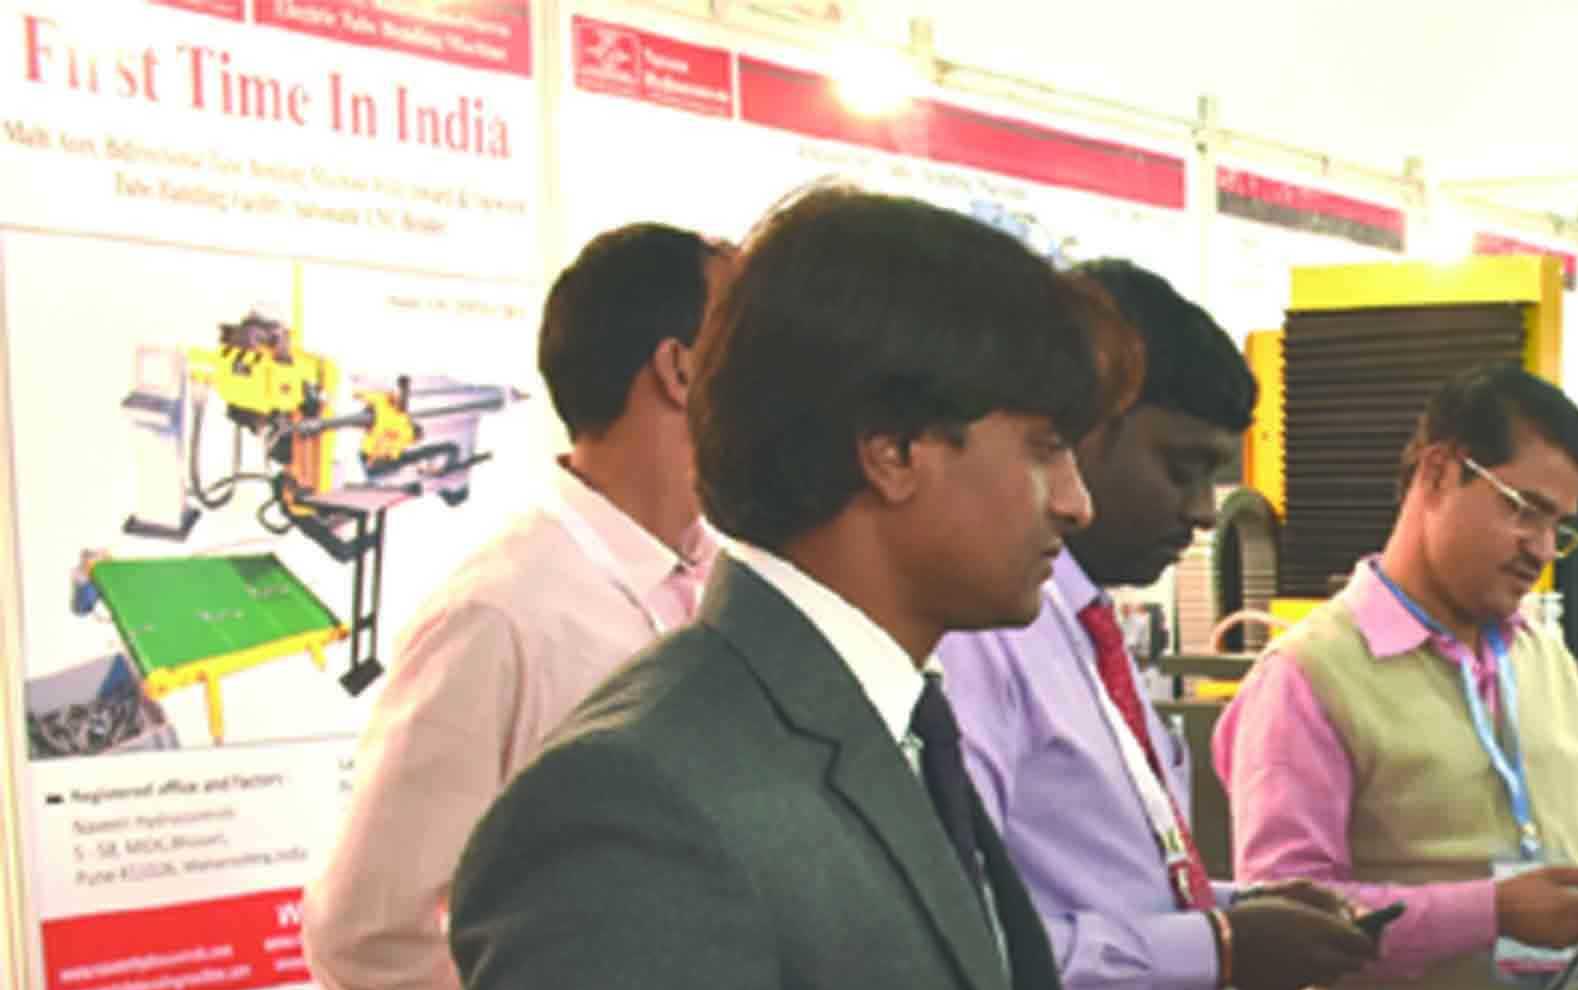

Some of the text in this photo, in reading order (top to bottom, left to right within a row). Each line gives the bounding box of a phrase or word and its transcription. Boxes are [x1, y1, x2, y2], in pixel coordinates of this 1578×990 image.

[22, 14, 511, 160] First Time In India
[70, 779, 153, 805] Registered
[158, 776, 198, 797] office
[204, 774, 232, 793] and
